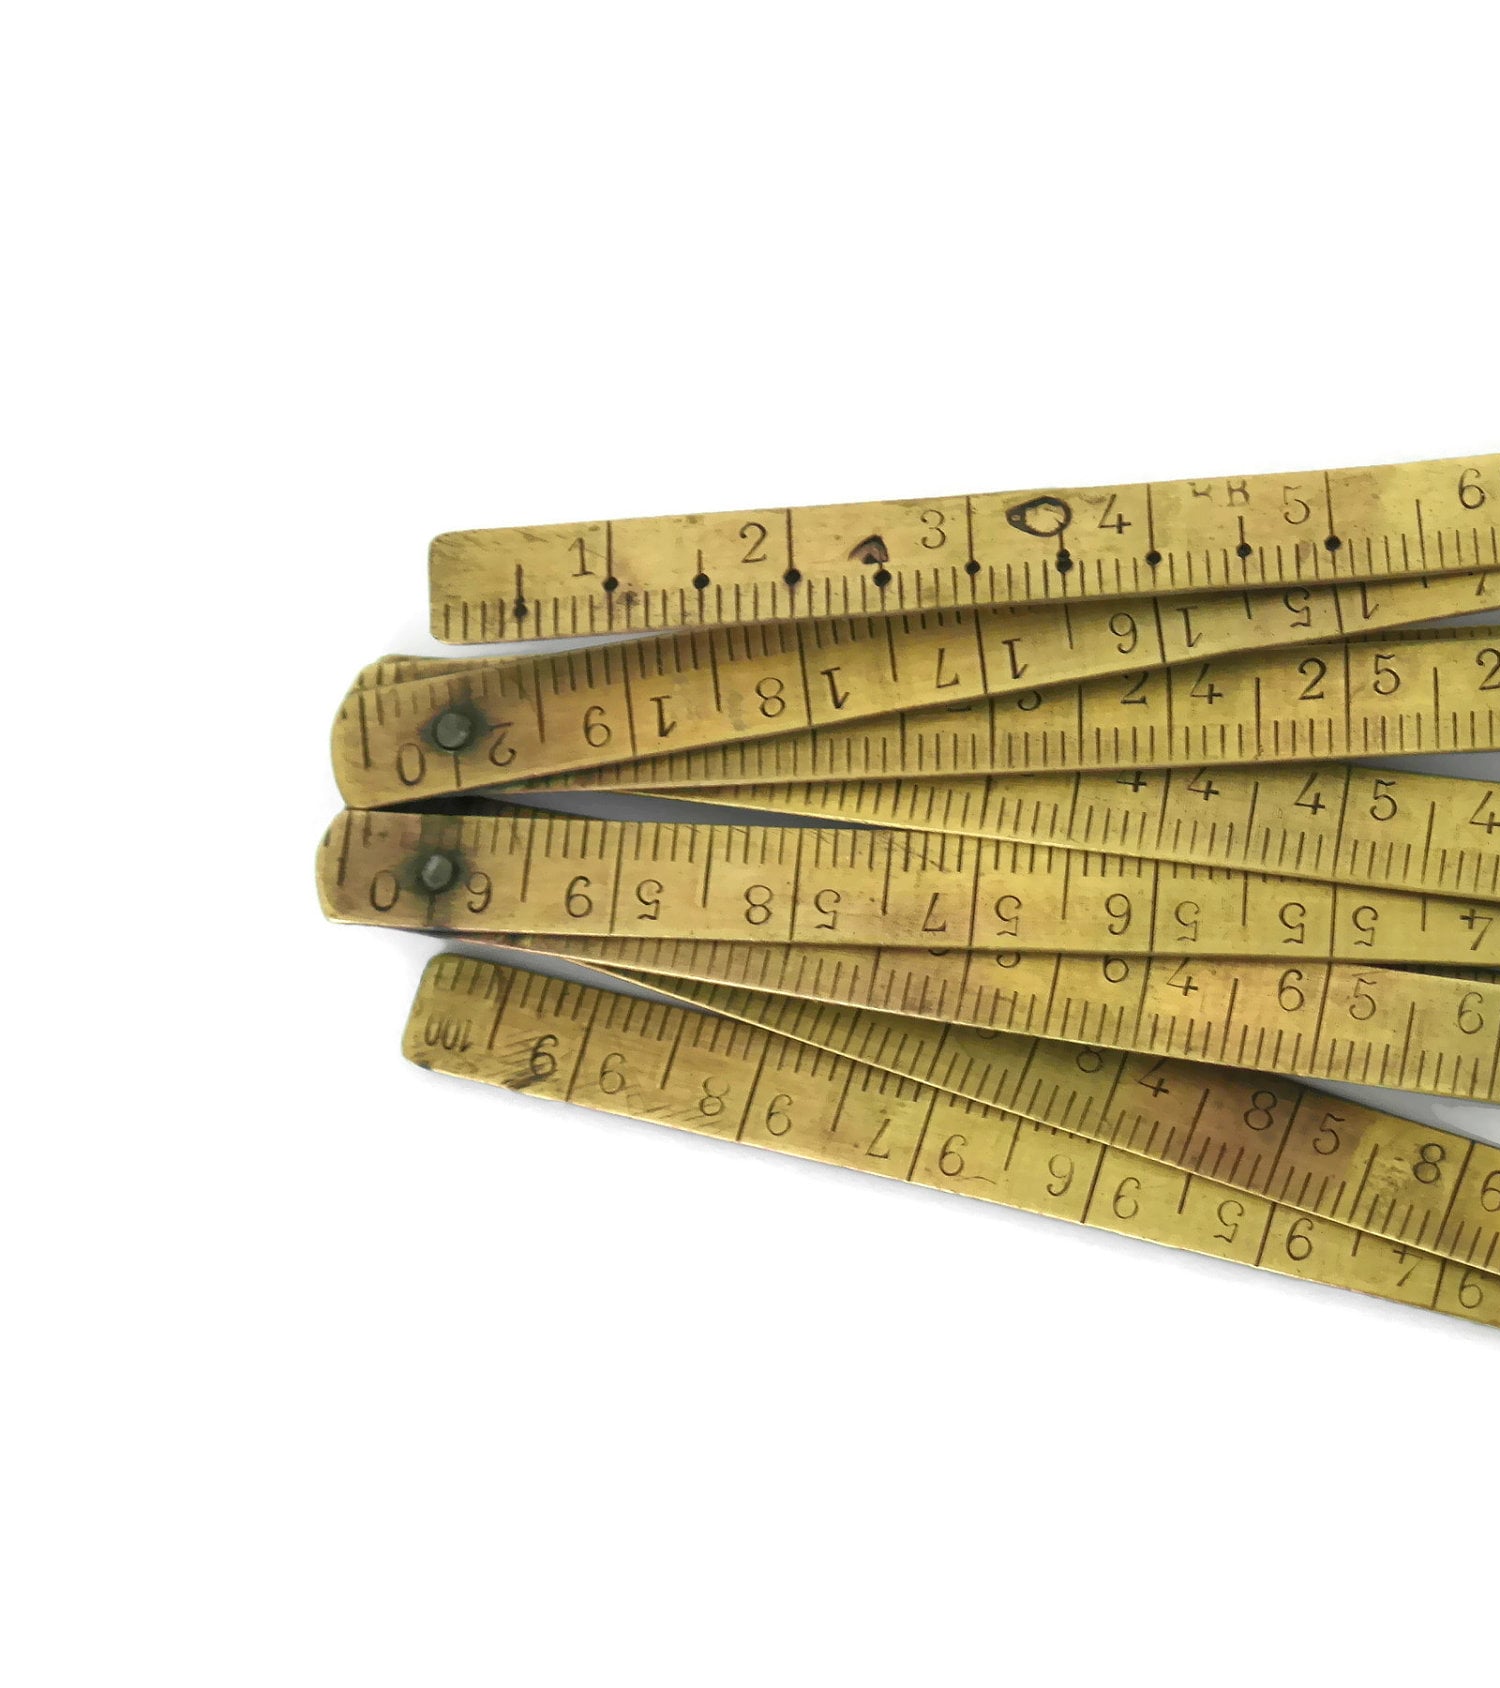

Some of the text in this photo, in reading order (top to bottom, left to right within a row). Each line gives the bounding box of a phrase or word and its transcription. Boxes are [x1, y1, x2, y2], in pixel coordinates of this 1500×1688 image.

[567, 537, 594, 577] 1
[739, 522, 768, 563] 2
[921, 509, 946, 549] 3
[1097, 493, 1131, 534] 4
[1283, 486, 1311, 524] 5
[1458, 468, 1485, 510] 6
[1176, 606, 1203, 648] 1
[1283, 588, 1311, 628] 5
[1108, 612, 1137, 654] 6
[935, 648, 960, 688] 7
[1002, 638, 1029, 679] 1
[1189, 663, 1223, 704] 4
[1299, 658, 1328, 701] 2
[1373, 654, 1401, 696] 5
[755, 677, 786, 717] 8
[820, 667, 850, 709] 1
[583, 705, 612, 748] 9
[650, 695, 677, 737] 1
[397, 742, 426, 785] 0
[488, 722, 516, 767] 2
[1294, 772, 1326, 815] 4
[1369, 779, 1398, 822] 5
[369, 869, 399, 912] 0
[464, 871, 492, 913] 6
[565, 875, 592, 918] 9
[636, 879, 663, 921] 5
[744, 884, 773, 925] 8
[814, 889, 840, 930] 5
[921, 892, 946, 932] 7
[994, 895, 1022, 936] 5
[1104, 893, 1131, 935] 6
[1174, 901, 1200, 942] 5
[1278, 902, 1306, 945] 5
[1351, 905, 1378, 946] 5
[1460, 909, 1493, 950] 4
[1167, 957, 1198, 997] 4
[1278, 968, 1305, 1011] 6
[1349, 978, 1377, 1020] 5
[1457, 992, 1484, 1034] 6
[424, 1013, 472, 1052] 100
[530, 1034, 559, 1076] 9
[600, 1052, 626, 1094] 9
[700, 1075, 729, 1116] 8
[766, 1093, 792, 1136] 9
[865, 1118, 890, 1159] 7
[1135, 1058, 1169, 1097] 4
[1243, 1090, 1278, 1131] 8
[1313, 1112, 1346, 1155] 5
[1413, 1143, 1446, 1184] 8
[938, 1134, 966, 1177] 9
[1046, 1153, 1074, 1196] 6
[1113, 1176, 1141, 1219] 9
[1213, 1200, 1244, 1243] 5
[1286, 1217, 1314, 1261] 9
